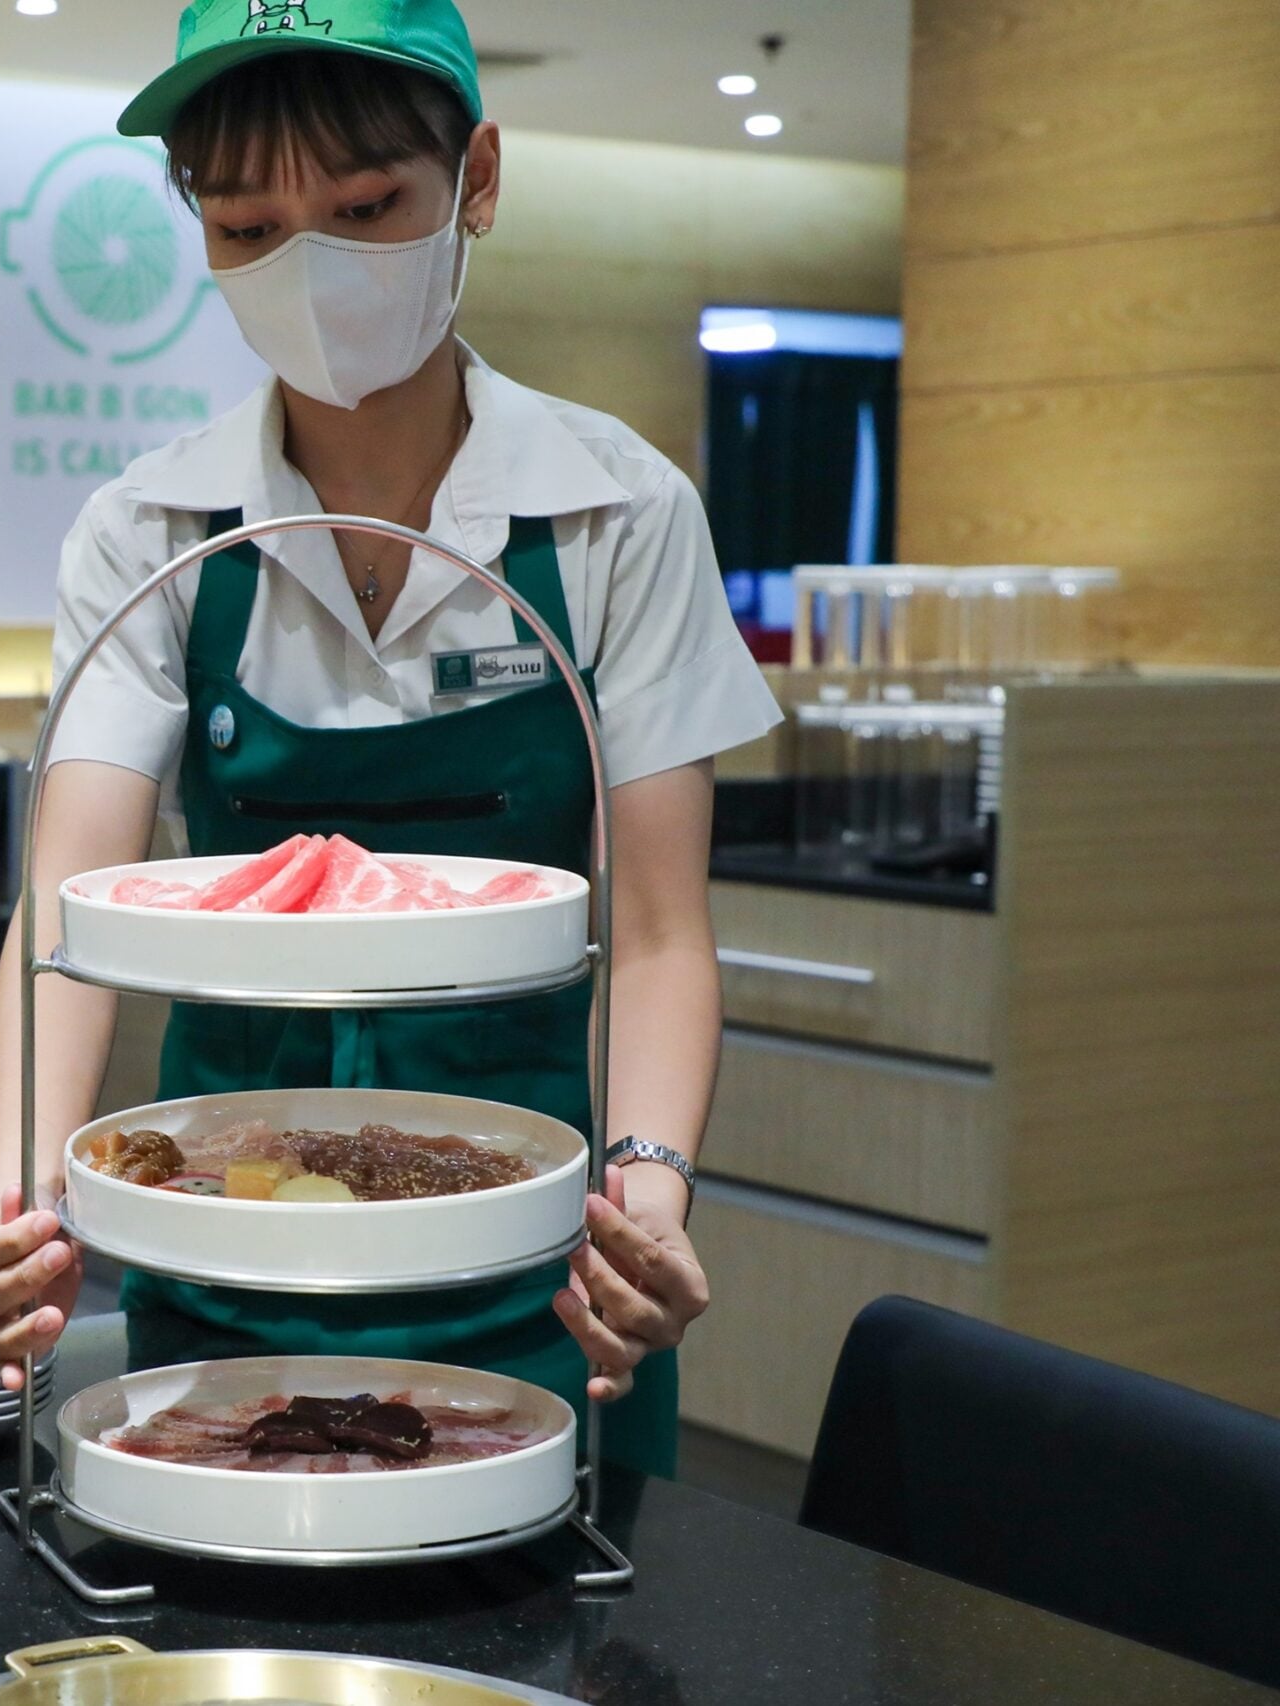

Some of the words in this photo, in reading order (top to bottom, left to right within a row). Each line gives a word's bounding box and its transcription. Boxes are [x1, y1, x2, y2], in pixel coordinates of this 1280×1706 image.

[14, 382, 86, 416] BAR
[100, 384, 122, 418] B
[134, 385, 209, 421] GON
